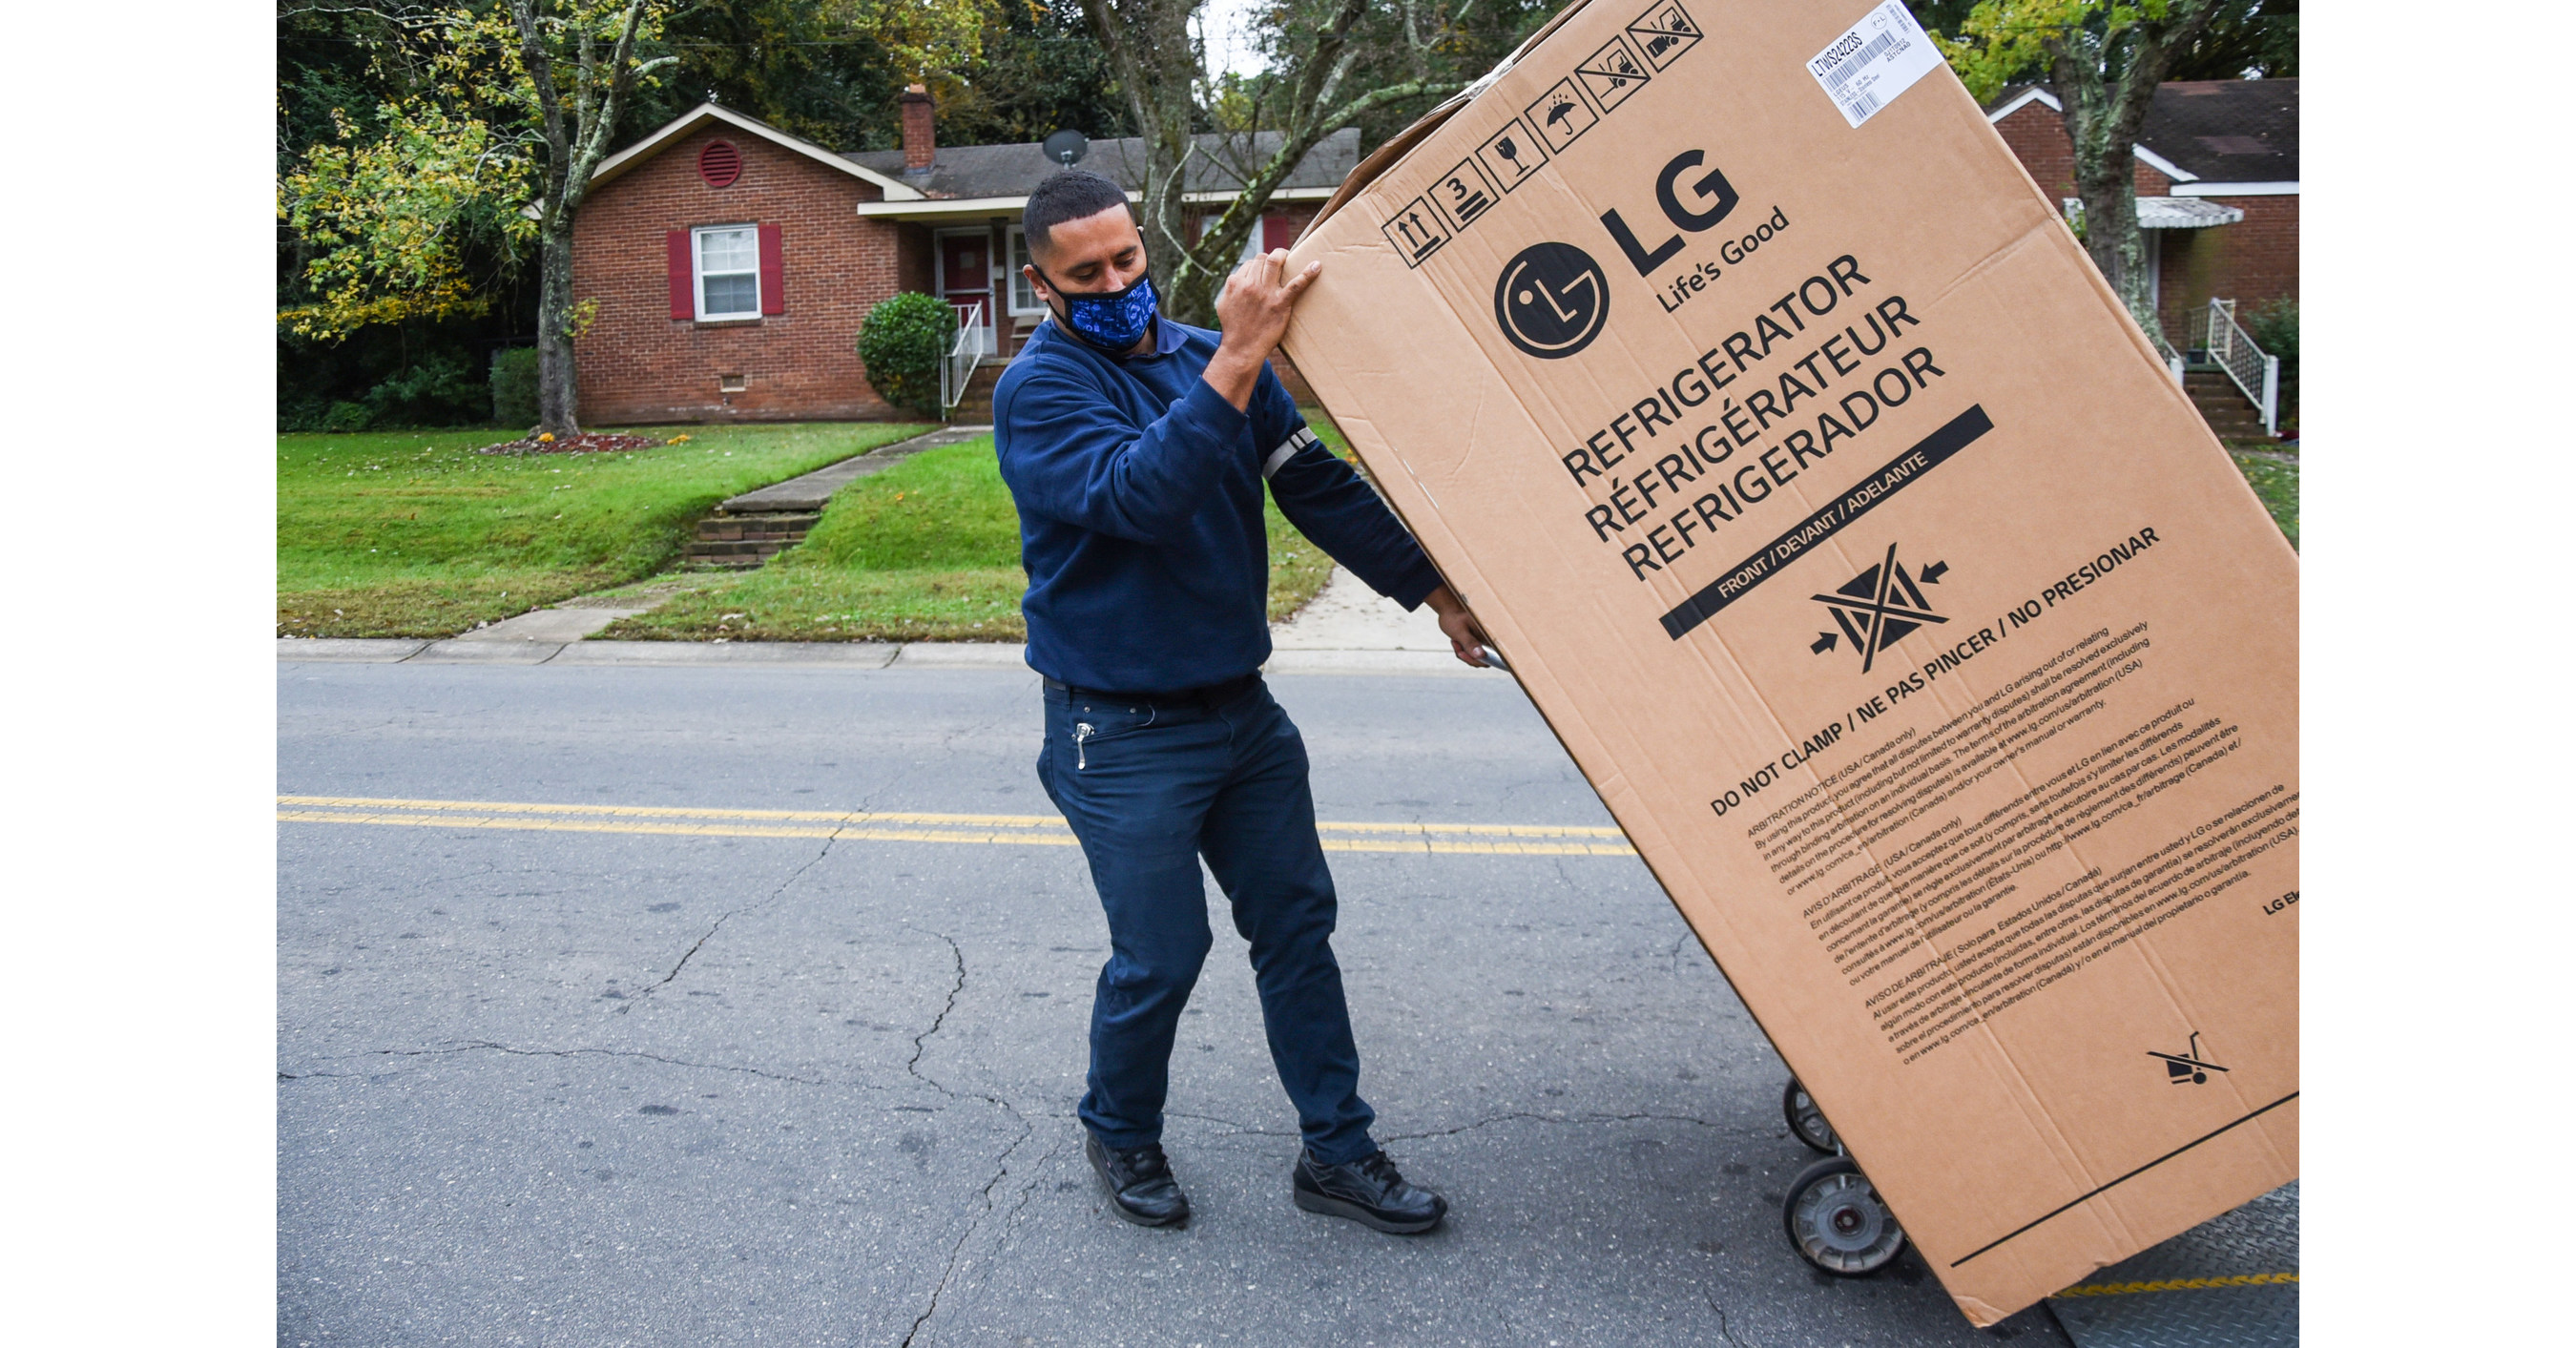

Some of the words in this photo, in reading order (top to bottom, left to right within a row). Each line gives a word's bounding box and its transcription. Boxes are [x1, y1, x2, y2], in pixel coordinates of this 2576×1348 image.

[1811, 31, 1863, 77] LTWS24223S
[1446, 178, 1466, 200] 3
[1600, 150, 1739, 278] LG
[1656, 262, 1720, 313] Life's
[1721, 205, 1789, 264] Good
[1562, 255, 1871, 487] REFRIGERATOR
[1586, 296, 1920, 543] RÉFRIGÉRATEUR
[1622, 347, 1945, 581] REFRIGERADOR
[1717, 556, 1768, 598] FRONT
[1775, 509, 1837, 559] DEVANT
[1847, 450, 1928, 513] ADELANTE
[1710, 790, 1740, 817] DO
[1739, 761, 1779, 798] NOT
[1781, 722, 1842, 770] CLAMP
[1856, 695, 1888, 723] NE
[1884, 672, 1924, 705] PAS
[1922, 628, 1998, 681] PINCER
[2006, 599, 2042, 629] NO
[2041, 527, 2160, 608] PRESIONAR
[1766, 824, 1789, 842] using
[1786, 815, 1803, 829] this
[1833, 785, 1850, 801] you
[1848, 772, 1873, 790] agree
[1871, 759, 1889, 776] that
[1887, 754, 1899, 766] all
[1898, 734, 1934, 759] disputes
[1931, 712, 1968, 738] between
[1966, 702, 1984, 718] you
[1983, 690, 2001, 707] and
[2013, 667, 2044, 689] arising
[2042, 656, 2058, 672] out
[2075, 627, 2109, 652] relating
[1747, 795, 1805, 839] ARBITRATION
[1803, 774, 1839, 801] NOTICE
[1862, 740, 1897, 764] Canada
[1894, 726, 1916, 745] only)
[1770, 849, 1802, 873] through
[1799, 831, 1831, 854] binding
[1829, 806, 1870, 836] arbitration
[1889, 768, 1930, 798] individual
[1927, 757, 1954, 775] basis.
[1951, 745, 1971, 758] The
[1968, 730, 1995, 750] terms
[2002, 716, 2017, 730] the
[2016, 691, 2061, 721] arbitration
[2059, 661, 2108, 695] agreement
[2106, 637, 2150, 669] (including
[1778, 863, 1806, 884] details
[1814, 849, 1829, 861] the
[1828, 823, 1868, 855] procedure
[1866, 816, 1880, 828] for
[1879, 795, 1917, 821] resolving
[1915, 771, 1954, 799] disputes)
[1960, 745, 1998, 772] available
[2114, 657, 2143, 681] (USA)
[1942, 841, 2003, 881] exclusivement
[2001, 834, 2016, 849] par
[2015, 813, 2054, 839] arbitrage
[2109, 771, 2127, 785] cas
[2125, 762, 2140, 778] par
[2140, 754, 2160, 767] cas.
[2158, 741, 2178, 757] Les
[1802, 900, 1823, 919] AVIS
[1907, 829, 1942, 853] Canada
[1940, 816, 1963, 834] only)
[1843, 932, 1879, 958] l'entente
[1877, 907, 1920, 937] d'arbitrage
[1926, 883, 1961, 906] compris
[1958, 876, 1974, 888] les
[1999, 851, 2013, 865] sur
[2118, 782, 2137, 797] des
[2182, 733, 2220, 762] peuvent
[2262, 899, 2285, 916] LG
[1859, 964, 1880, 980] votre
[1880, 943, 1911, 967] manuel
[1864, 987, 1892, 1009] AVISO
[1904, 950, 1954, 985] ARBITRAJE
[1956, 939, 1977, 954] Solo
[1975, 927, 1997, 944] para
[1996, 907, 2033, 931] Estados
[2030, 890, 2063, 911] Unidos
[1895, 1036, 1920, 1054] sobre
[1981, 988, 2002, 1006] para
[2000, 969, 2034, 993] resolver
[2032, 947, 2072, 975] disputas)
[2095, 909, 2145, 941] disponibles
